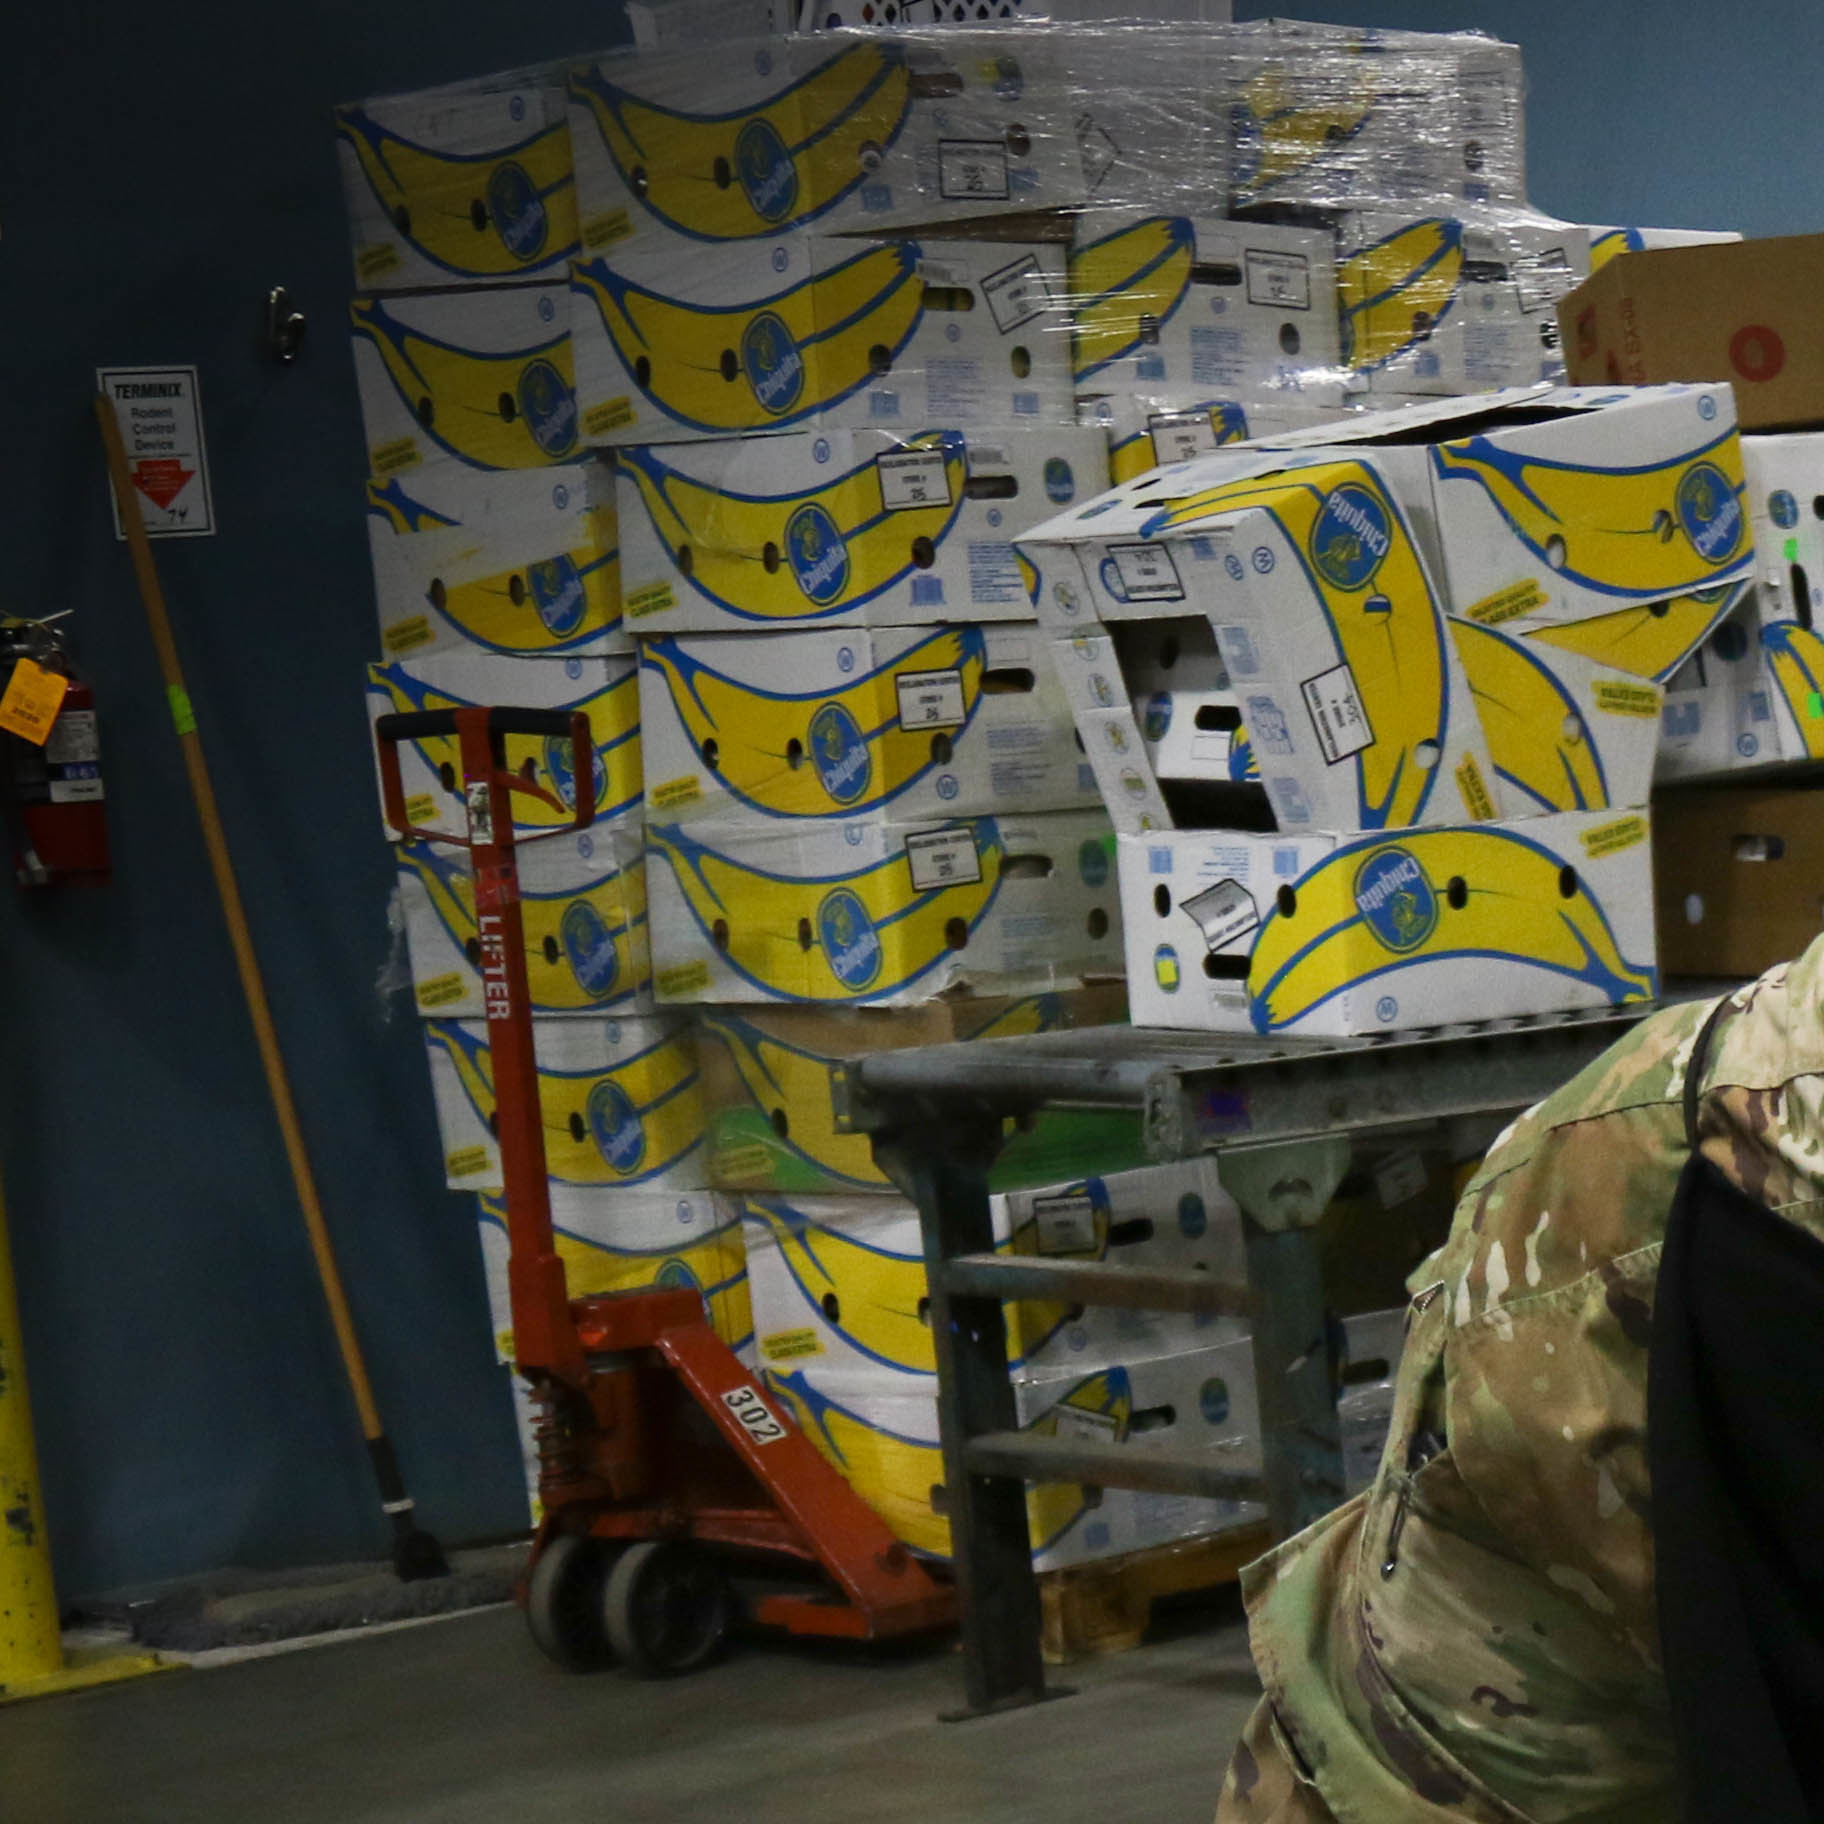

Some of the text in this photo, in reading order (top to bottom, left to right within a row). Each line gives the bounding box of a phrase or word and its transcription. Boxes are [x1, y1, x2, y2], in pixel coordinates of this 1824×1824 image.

[114, 383, 182, 400] TERMINIX
[131, 408, 173, 419] Rodent
[132, 424, 176, 435] Control
[134, 440, 174, 451] Device
[479, 915, 511, 1021] LIFTER
[726, 1390, 781, 1441] 302
